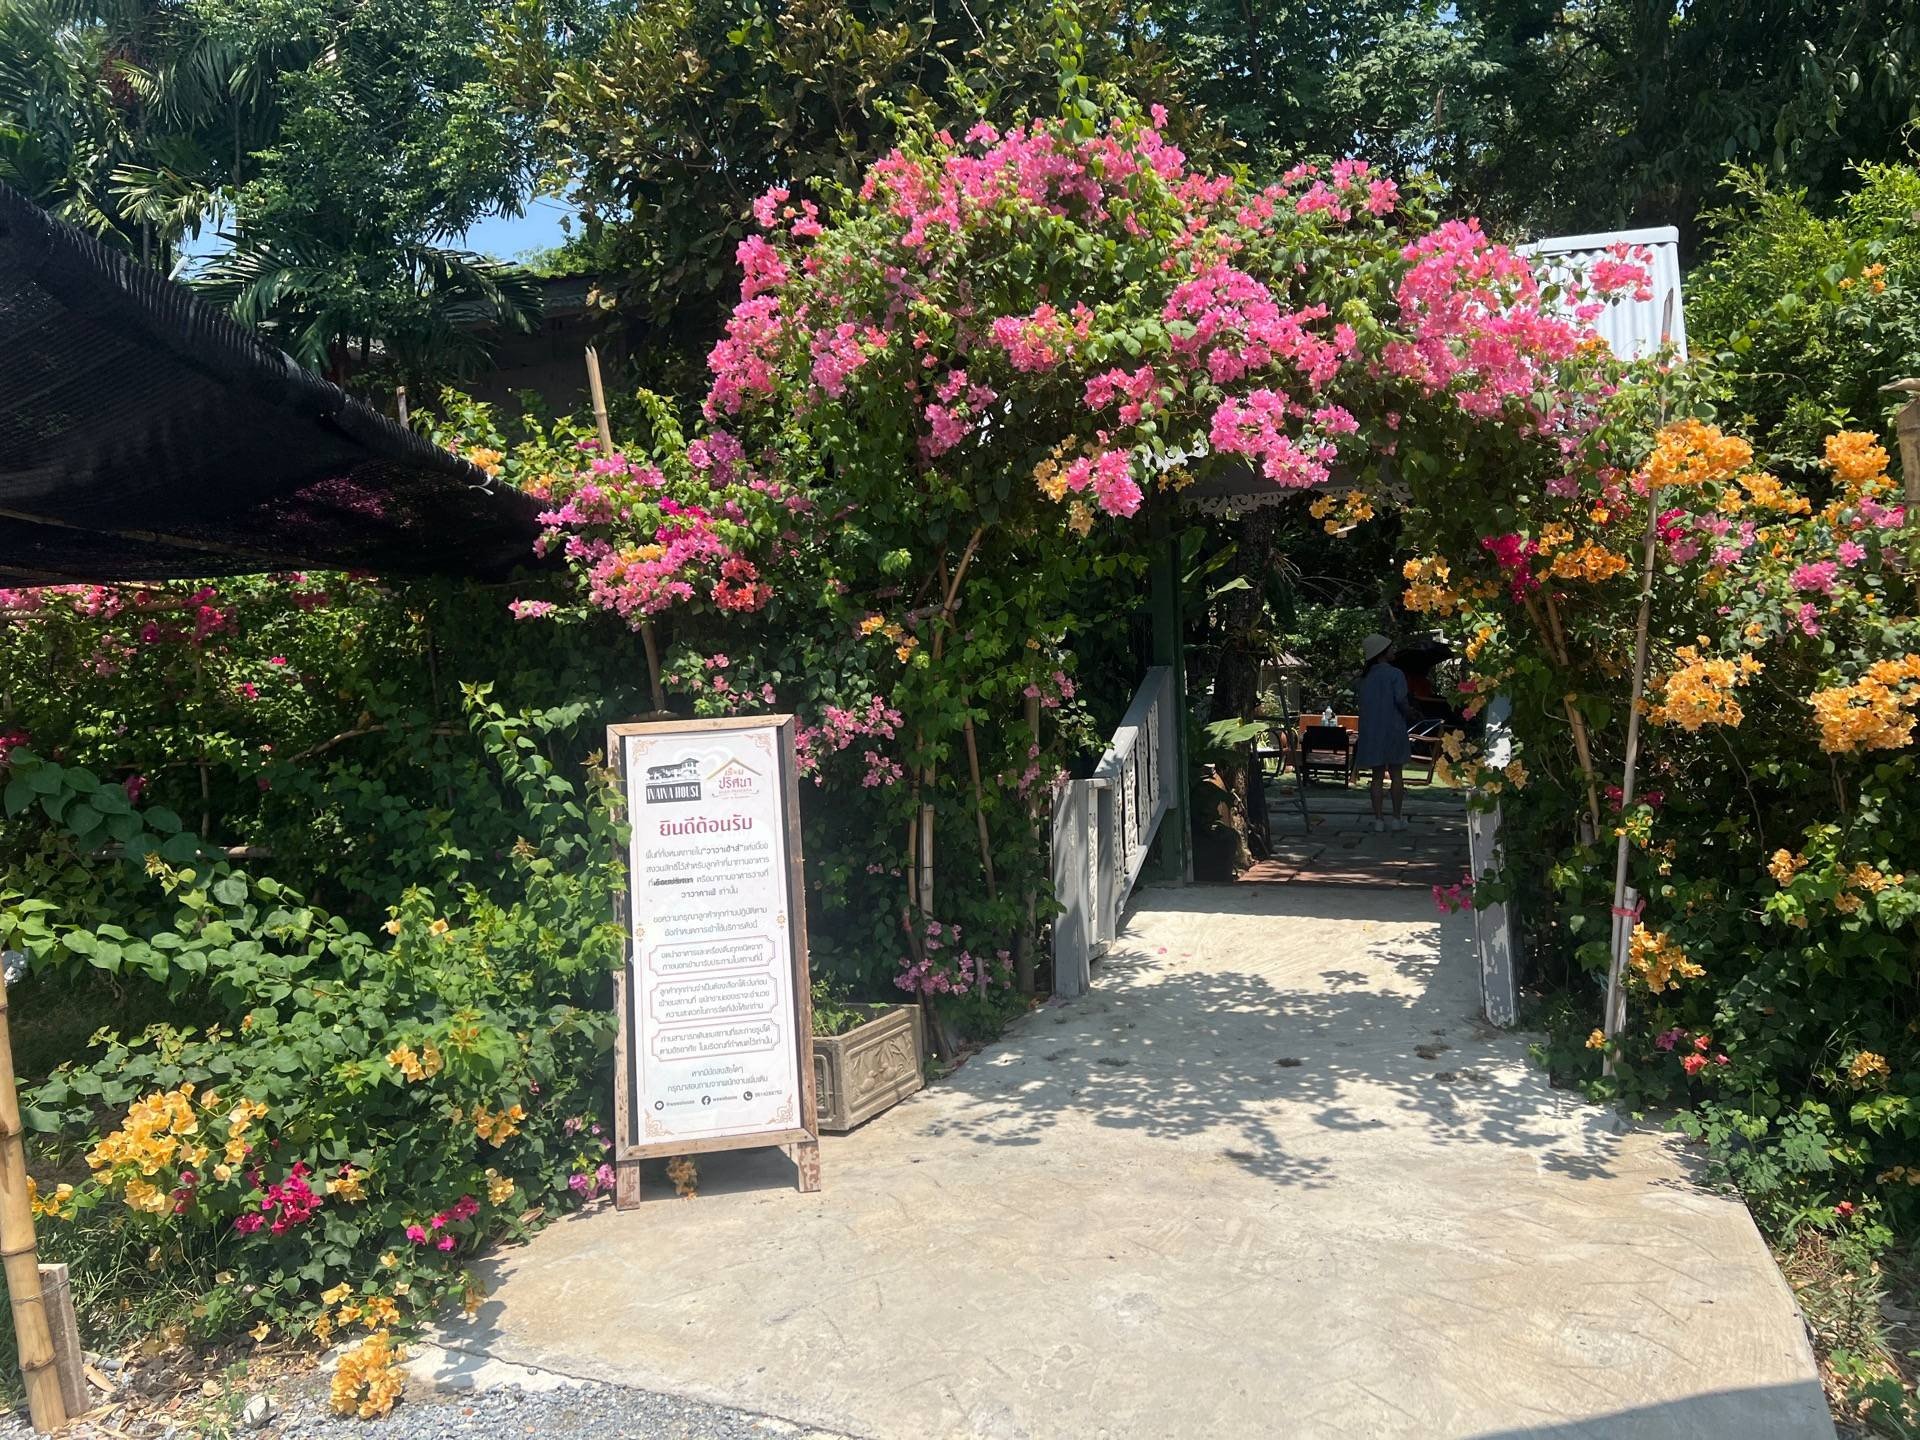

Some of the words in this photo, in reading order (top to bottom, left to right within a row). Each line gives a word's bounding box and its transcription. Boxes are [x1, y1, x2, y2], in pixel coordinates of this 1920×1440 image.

[719, 776, 752, 789] ปริศนา
[659, 814, 753, 837] ยินดีต้อนรับ
